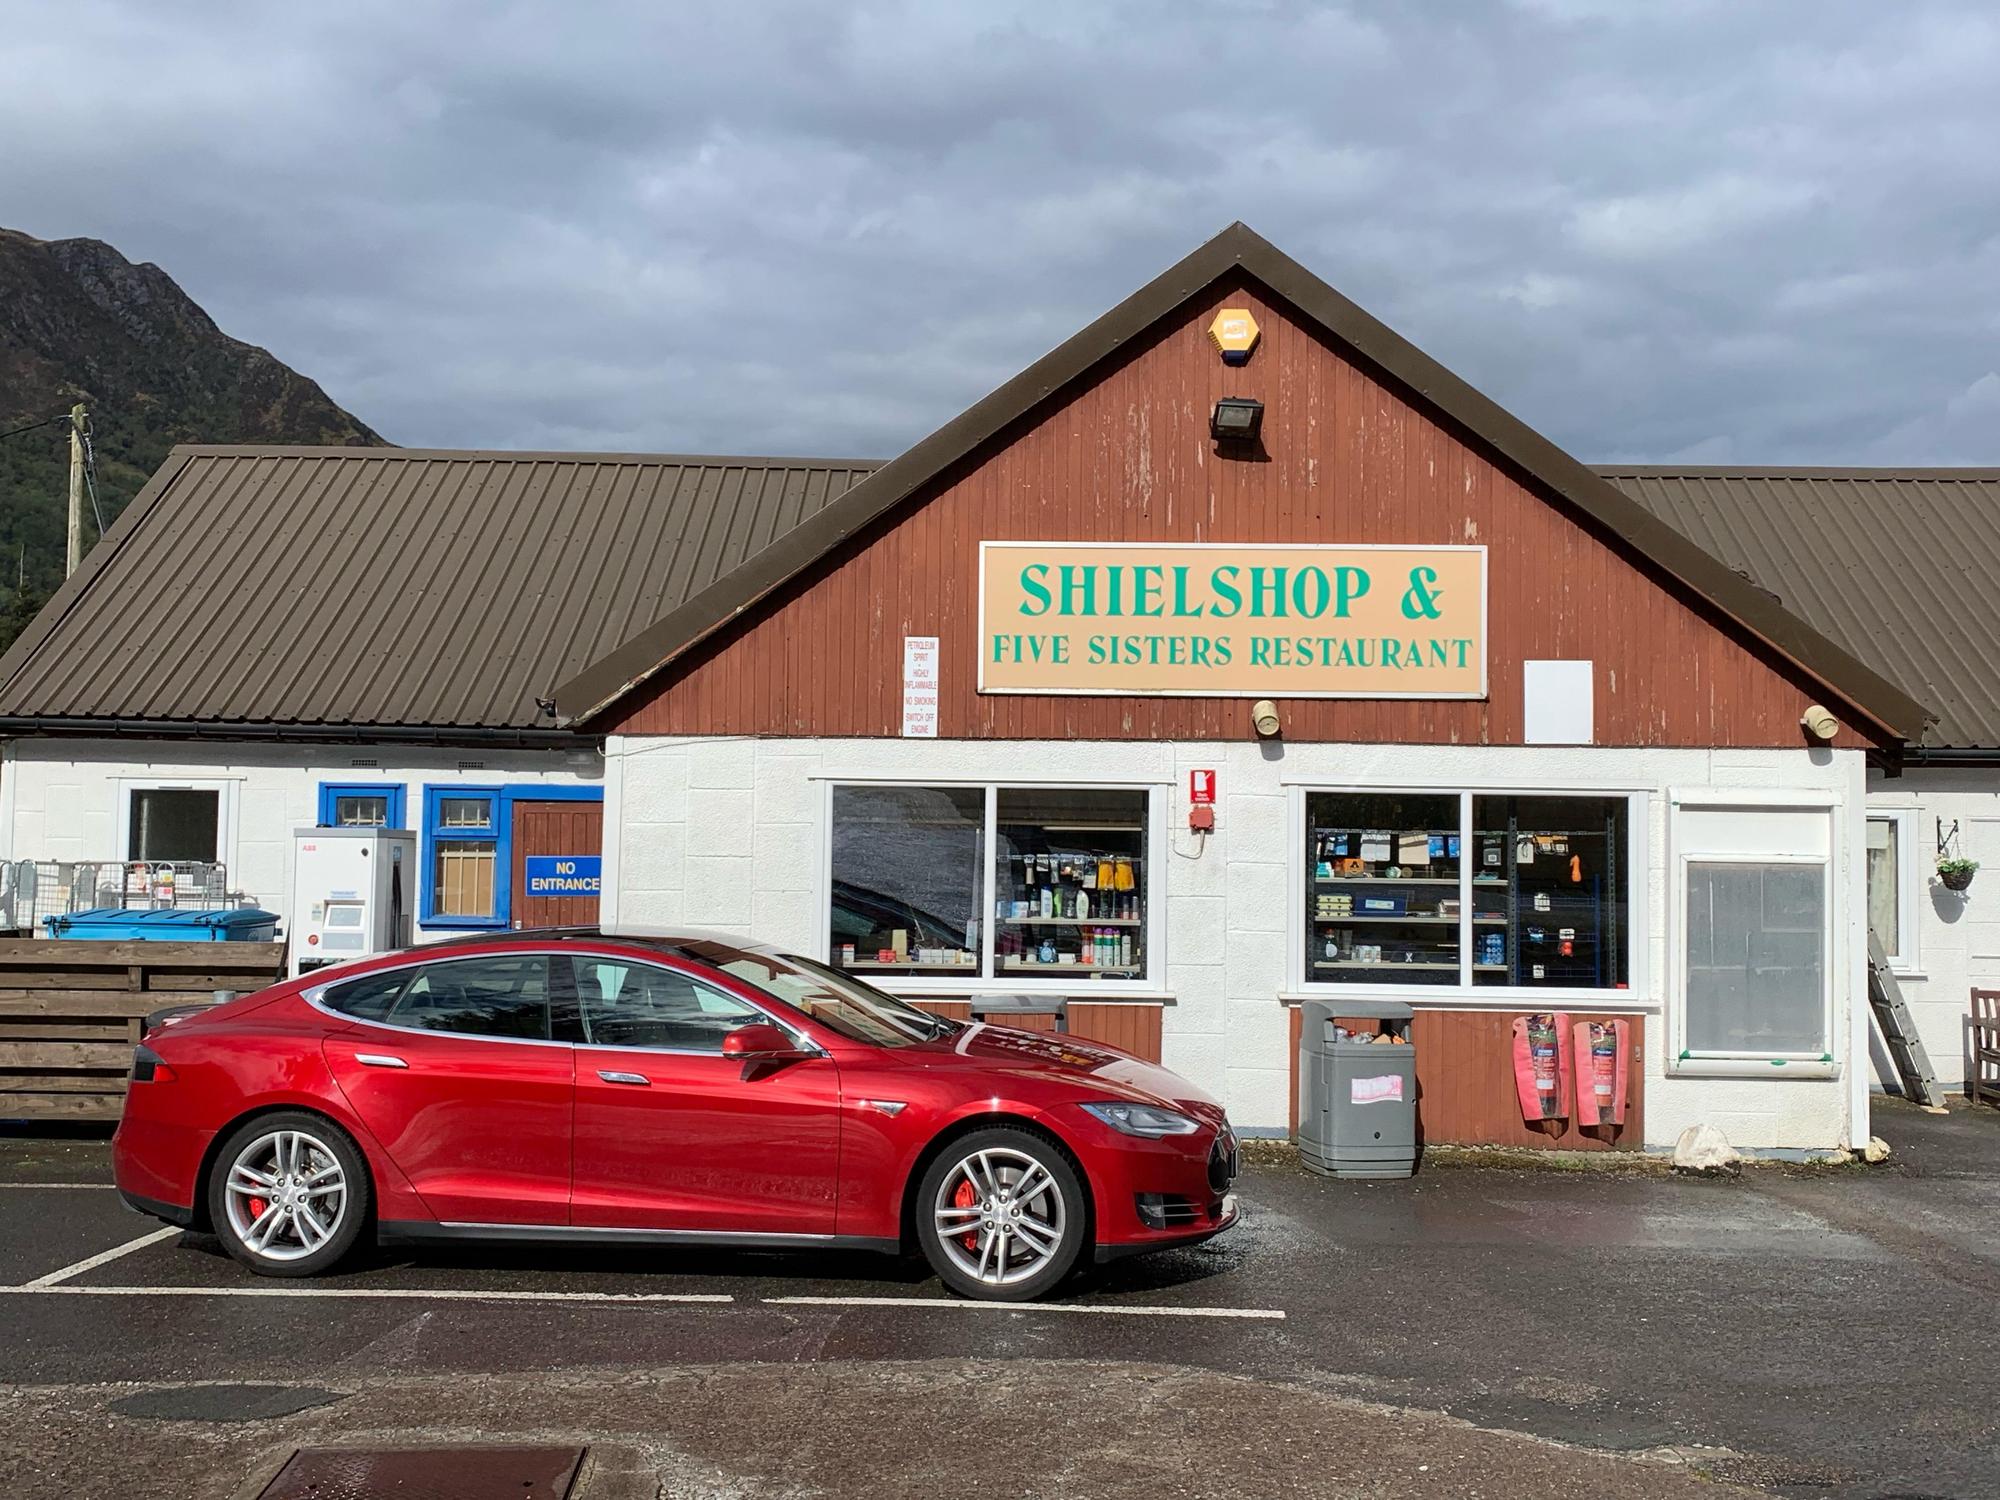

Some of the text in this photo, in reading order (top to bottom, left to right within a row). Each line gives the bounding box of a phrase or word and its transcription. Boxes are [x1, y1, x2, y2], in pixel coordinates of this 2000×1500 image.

[1018, 563, 1443, 620] SHIELSHOP &
[906, 640, 936, 650] PETROLEUM
[992, 634, 1474, 669] FIVE SISTERS RESTAURANT
[913, 653, 928, 662] SPIRIT
[913, 669, 929, 678] HIGHLY
[905, 681, 937, 690] INFLAMMABLE
[905, 697, 936, 706] NO SMOKING
[905, 713, 935, 722] SWITCH OFF
[911, 725, 929, 734] ENGINE
[556, 862, 576, 875] NO
[531, 878, 600, 891] ENTRANCE
